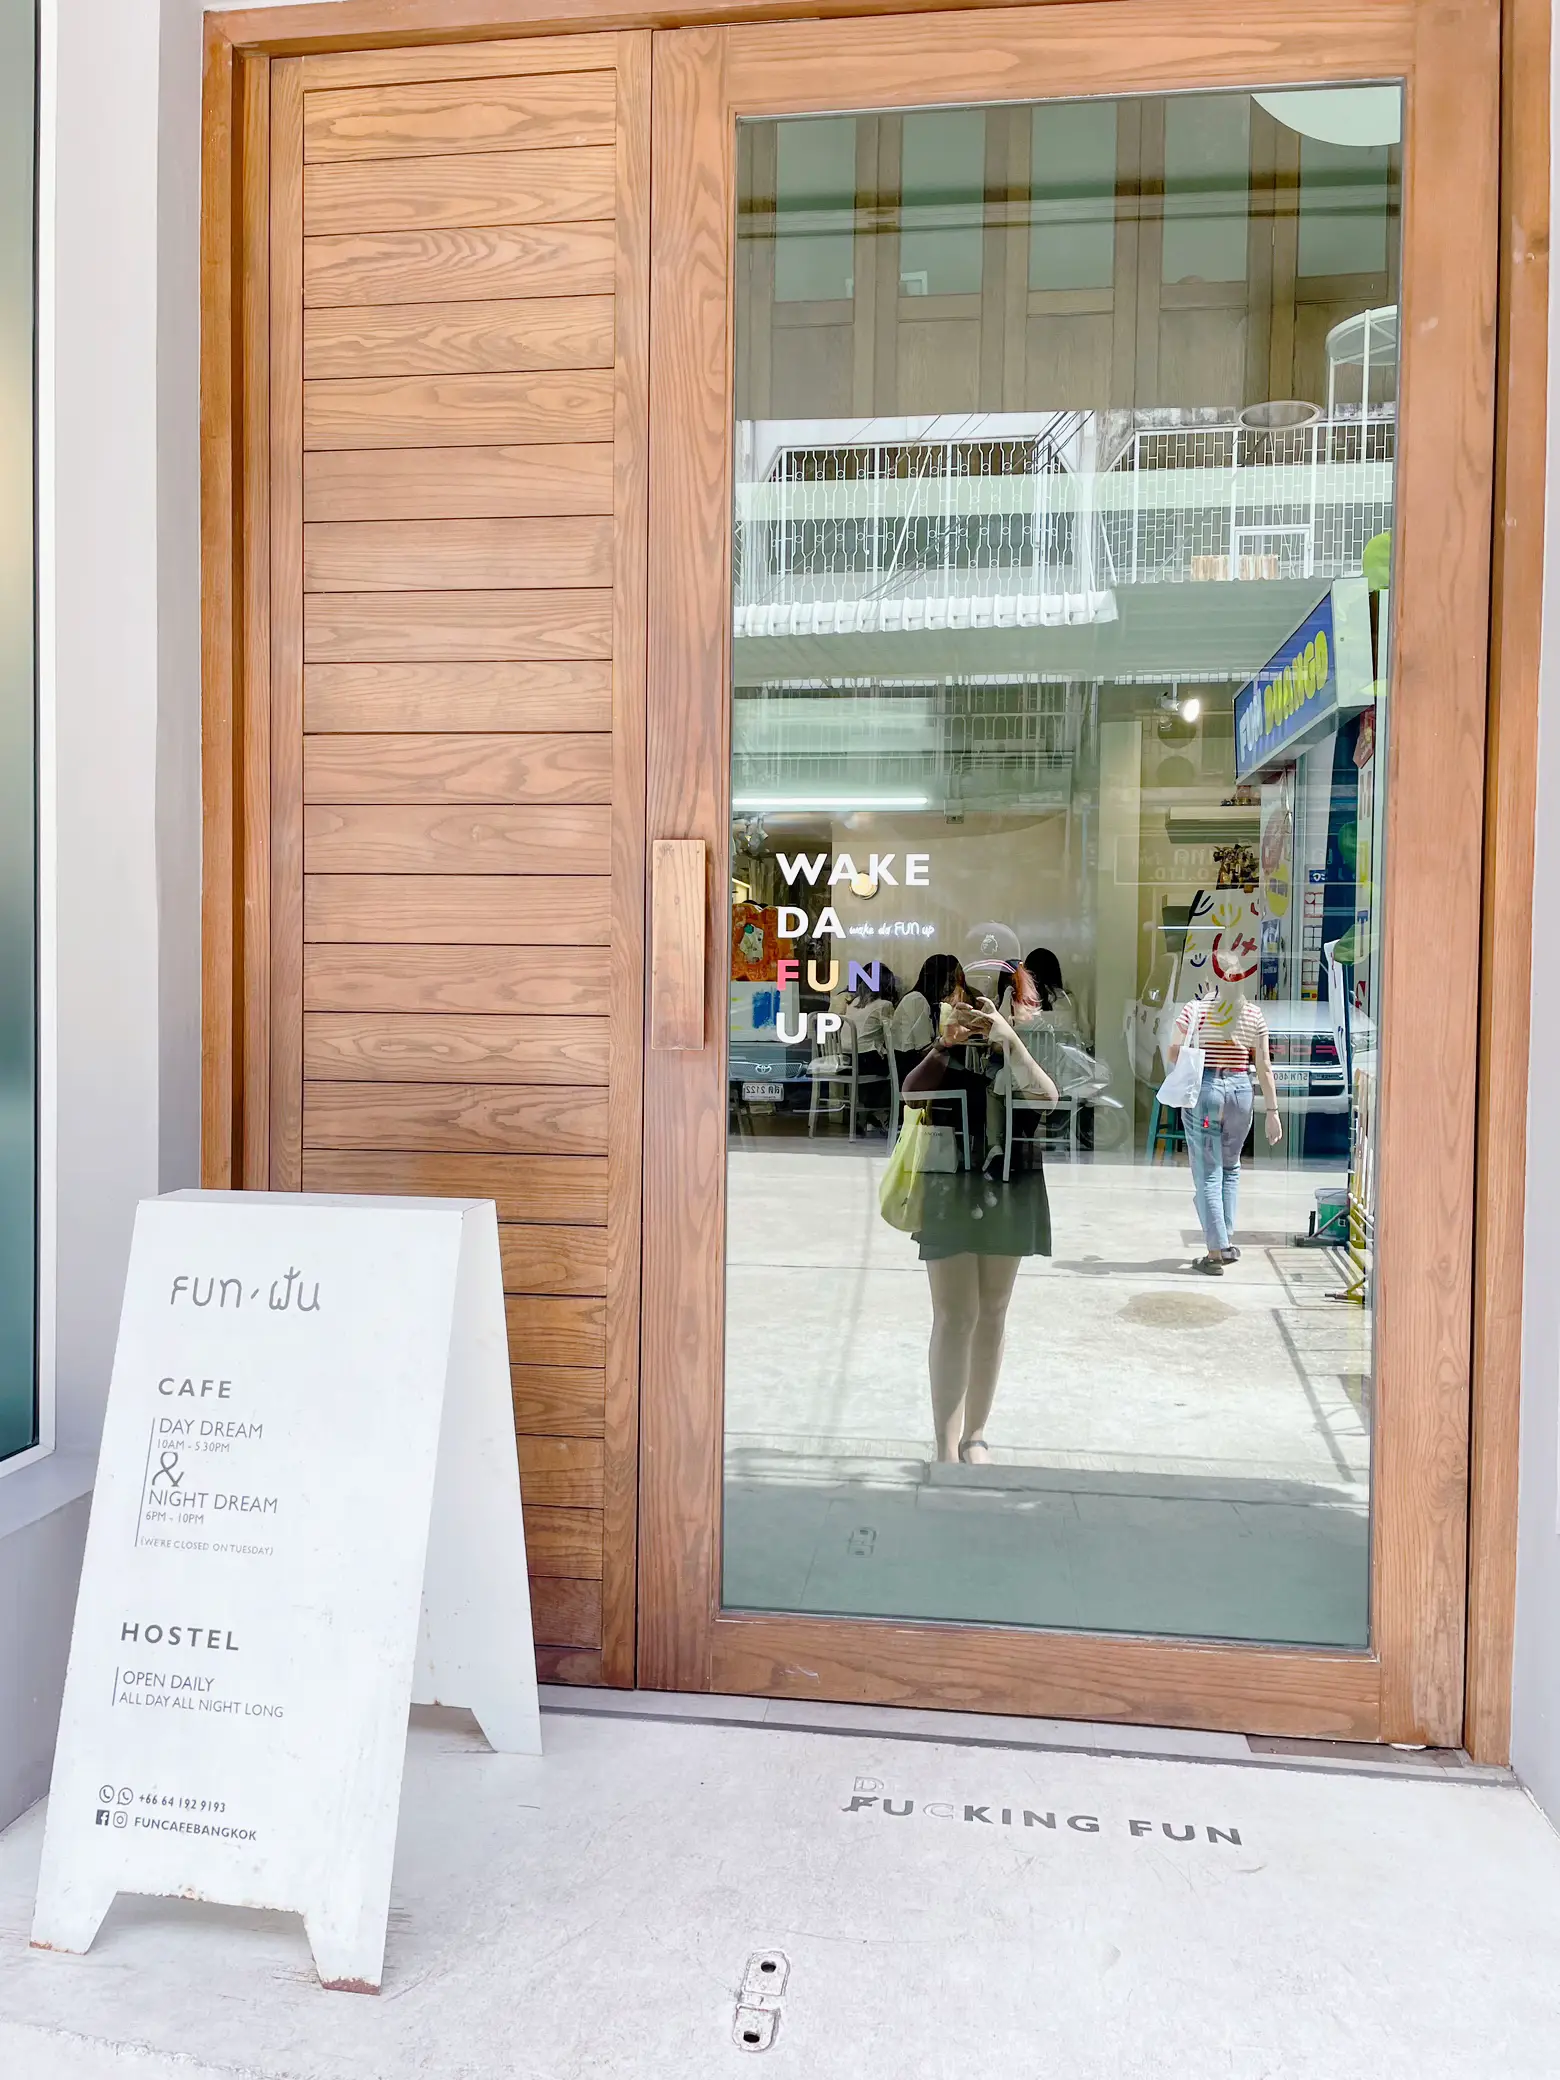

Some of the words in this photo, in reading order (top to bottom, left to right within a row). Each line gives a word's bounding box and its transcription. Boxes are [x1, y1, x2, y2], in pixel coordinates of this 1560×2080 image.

[775, 852, 931, 887] WAKE
[776, 905, 847, 939] DA
[894, 921, 919, 936] FUN
[921, 925, 935, 938] up
[776, 959, 882, 992] FUN
[776, 1012, 842, 1045] UP
[170, 1275, 242, 1308] FUN
[158, 1377, 232, 1399] CAFE
[159, 1418, 195, 1435] DAY
[200, 1420, 263, 1439] DREAM
[157, 1438, 185, 1450] 10AM
[151, 1451, 185, 1488] &
[148, 1489, 209, 1509] NIGHT
[214, 1493, 278, 1514] DREAM
[145, 1510, 166, 1522] 6PM
[178, 1513, 204, 1525] 10PM
[173, 1539, 209, 1551] CLOSED
[212, 1543, 228, 1552] ON
[120, 1621, 240, 1652] HOSTEL
[122, 1670, 166, 1688] OPEN
[170, 1674, 215, 1693] DAILY
[118, 1691, 143, 1706] ALL
[145, 1693, 171, 1708] DAY
[171, 1696, 195, 1711] ALL
[198, 1699, 242, 1715] NIGHT
[244, 1702, 285, 1718] LONG
[138, 1793, 158, 1806] +66
[161, 1795, 174, 1808] 64
[178, 1797, 197, 1810] 192
[200, 1799, 226, 1814] 9193
[134, 1816, 257, 1841] FUNCAFEBANGKOK
[1128, 1818, 1243, 1846] FUN
